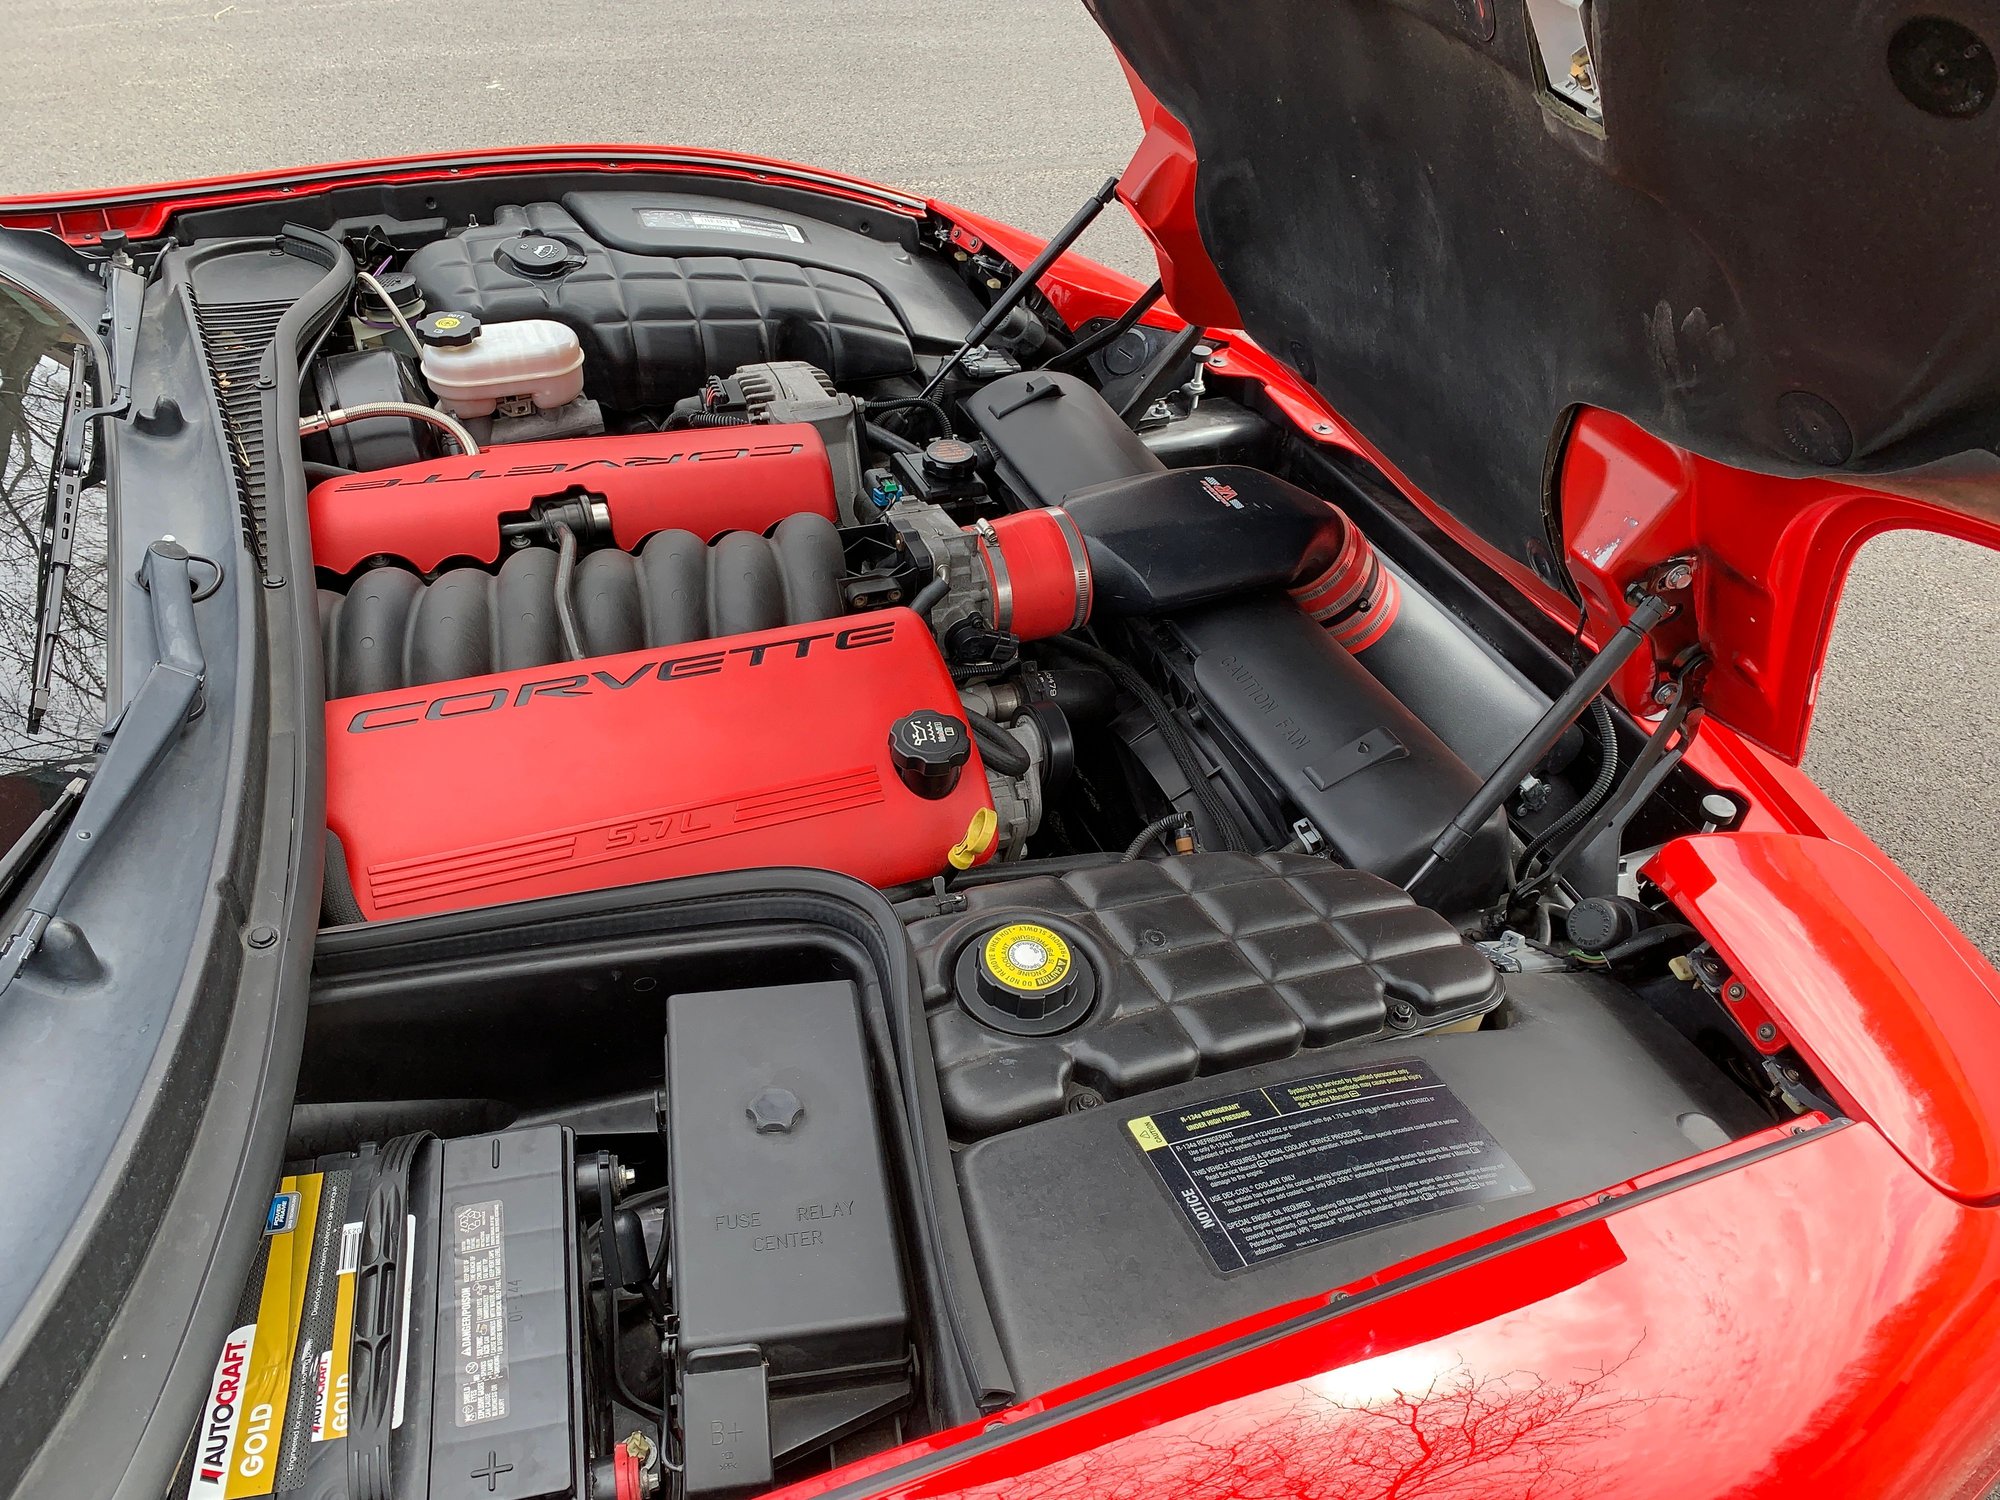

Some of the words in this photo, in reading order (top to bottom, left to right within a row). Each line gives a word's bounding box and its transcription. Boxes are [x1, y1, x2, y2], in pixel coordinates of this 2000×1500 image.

[334, 443, 805, 493] CORVETTE
[347, 621, 896, 734] CORVETTE
[1221, 655, 1279, 714] CAUTION
[1275, 716, 1311, 750] FAN
[605, 812, 712, 850] 5.7L
[999, 929, 1012, 938] HOT
[1010, 935, 1048, 947] PRESSURE
[1019, 926, 1047, 935] SLOWLY
[989, 937, 1001, 953] WHEN
[1048, 934, 1067, 954] REMOVE
[989, 954, 1006, 976] REMOVE
[1001, 943, 1015, 971] COOLANT
[1005, 975, 1020, 984] NOT
[1017, 968, 1047, 977] ENGINE
[1037, 966, 1062, 985] CAUTION
[1179, 1112, 1202, 1122] R-134a
[1200, 1103, 1241, 1117] REFRIGERANT
[1185, 1121, 1207, 1131] UNDER
[1206, 1117, 1222, 1125] HIGH
[1220, 1110, 1251, 1122] PRESSURE
[1144, 1121, 1162, 1143] CAUTION
[1175, 1141, 1198, 1151] R-134a
[1196, 1131, 1234, 1146] REFRIGERANT
[1205, 1162, 1230, 1172] VEHICLE
[1228, 1154, 1257, 1166] REQUIRES
[1260, 1148, 1285, 1157] SPECIAL
[1283, 1141, 1310, 1152] COOLANT
[1308, 1136, 1332, 1145] SERVICE
[1330, 1128, 1363, 1140] PROCEDURE
[1254, 1178, 1282, 1190] COOLANT
[1280, 1174, 1297, 1182] ONLY
[329, 1186, 338, 1211] arranque
[1182, 1187, 1215, 1228] NOTICE
[326, 1212, 334, 1220] de
[715, 1212, 762, 1231] FUSE
[798, 1200, 854, 1222] RELAY
[1226, 1217, 1252, 1229] SPECIAL
[1250, 1211, 1273, 1222] ENGINE
[1282, 1200, 1312, 1213] REQUIRED
[323, 1221, 332, 1246] potencia
[753, 1230, 824, 1252] CENTER
[462, 1287, 471, 1347] DANGER/POISON
[204, 1341, 248, 1467] AUTOCRAFT
[332, 1374, 349, 1432] GOLD
[287, 1431, 300, 1471] Engineered
[296, 1386, 306, 1419] maximum
[240, 1403, 273, 1478] GOLD
